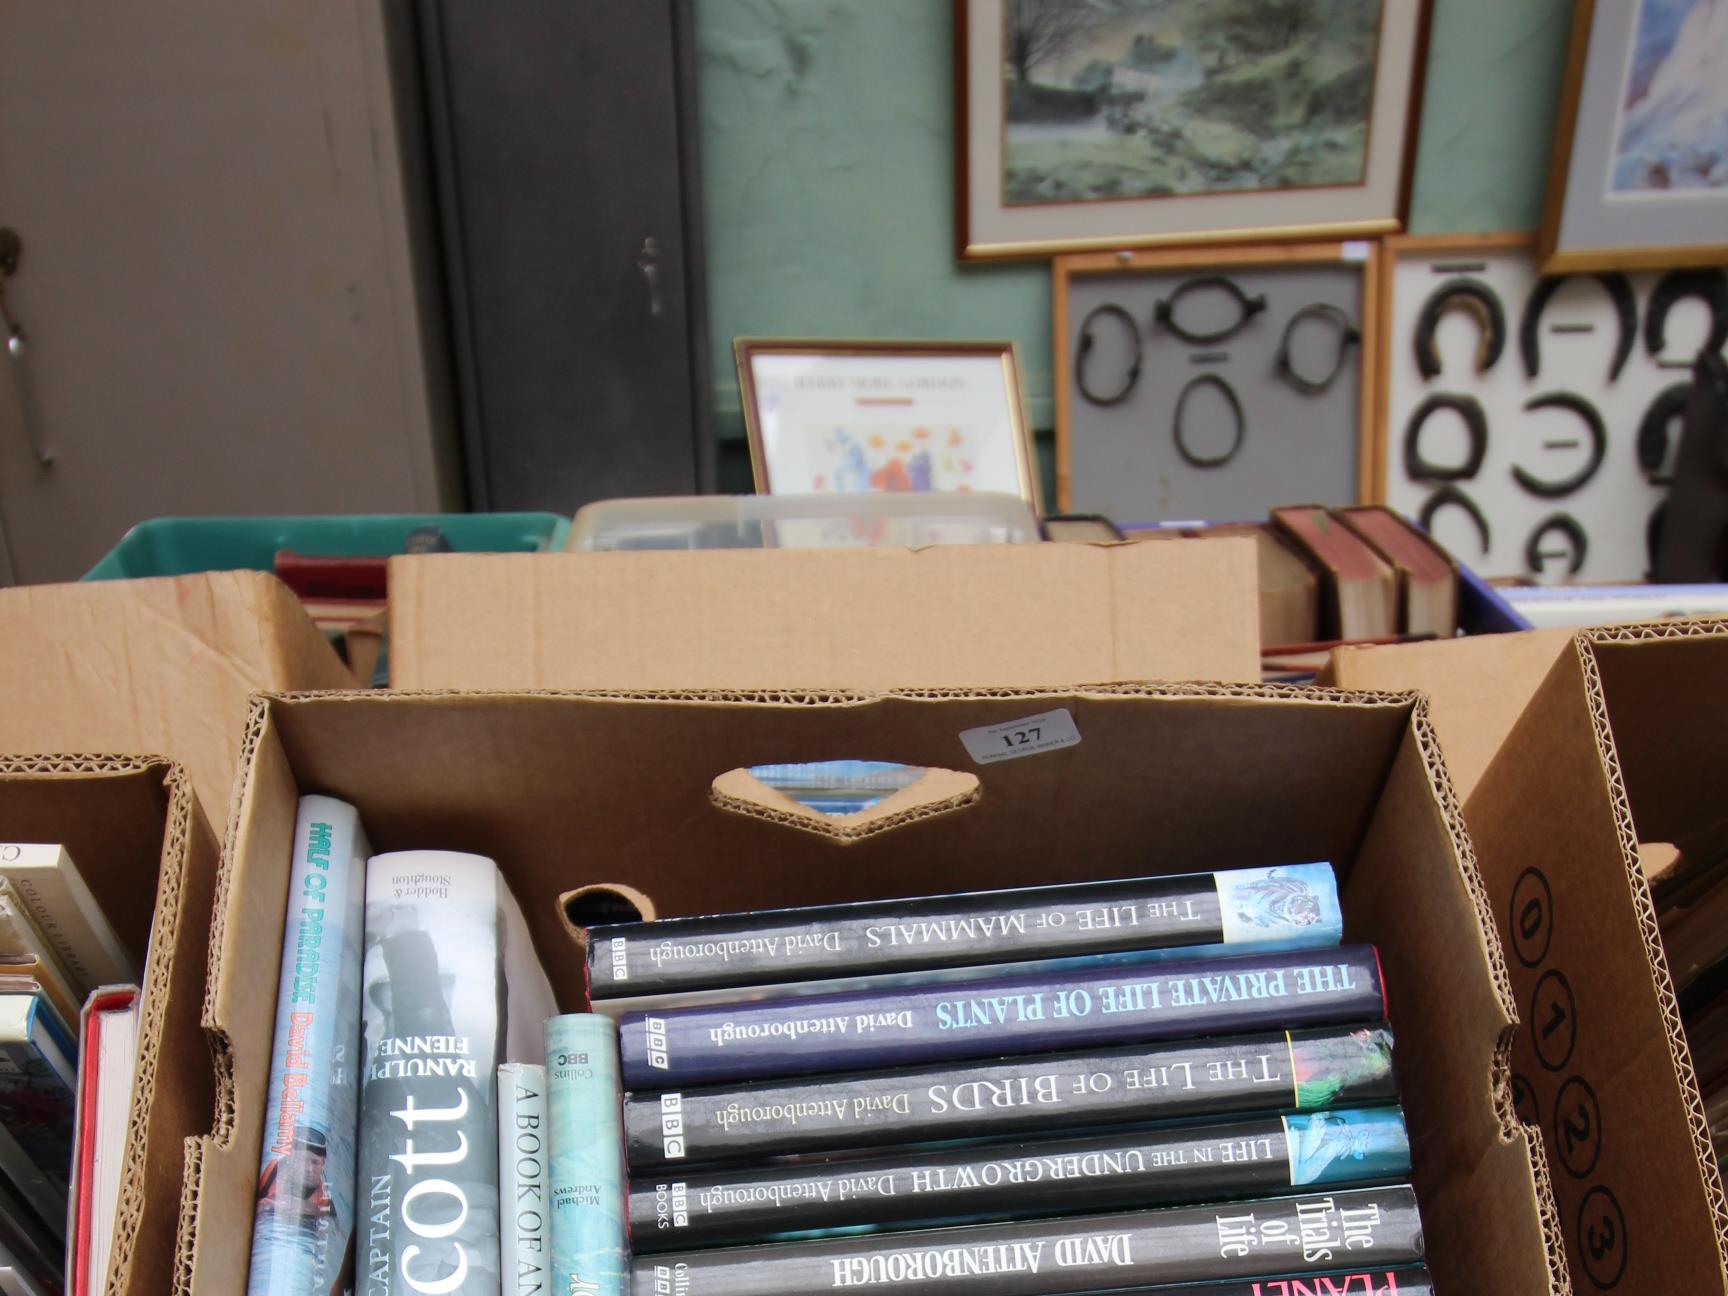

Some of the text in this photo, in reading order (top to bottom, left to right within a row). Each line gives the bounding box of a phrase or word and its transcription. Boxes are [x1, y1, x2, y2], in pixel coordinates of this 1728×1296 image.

[1002, 727, 1041, 747] 127
[391, 873, 451, 886] Stoughton
[404, 887, 448, 899] Hodder
[292, 823, 332, 1005] HALF OF PARADISE
[865, 912, 1027, 948] MAMMALS
[1036, 911, 1065, 927] OF
[1076, 905, 1138, 930] LIFE
[612, 937, 627, 980] BBC
[650, 931, 841, 967] David Attenborough
[936, 964, 1355, 1030] THE PRIVATE LIFE OF PLANTS
[645, 1016, 668, 1069] BBC
[710, 1010, 913, 1046] David Attenborough
[554, 1069, 593, 1080] Collins
[558, 1053, 588, 1065] BBC
[272, 1011, 314, 1154] David Bellamy
[516, 1085, 539, 1104] A
[928, 1074, 1060, 1114] BIRDS
[1071, 1072, 1111, 1094] OF
[661, 1093, 685, 1159] BBC
[715, 1092, 910, 1131] David Attenborough
[516, 1112, 541, 1203] BOOK
[911, 1138, 1272, 1192] LIFE IN THE UNDERGROWTH
[554, 1185, 602, 1195] Andrews
[557, 1196, 600, 1209] Michael
[657, 1184, 667, 1229] BOOKS
[672, 1182, 687, 1227] BBC
[699, 1174, 896, 1213] David Attenborough
[517, 1210, 543, 1253] OF
[1214, 1211, 1255, 1259] Life
[1259, 1218, 1299, 1250] of
[1296, 1196, 1337, 1263] Trials
[1339, 1202, 1380, 1250] The
[830, 1232, 1134, 1287] DAVID ATTENBOROUGH
